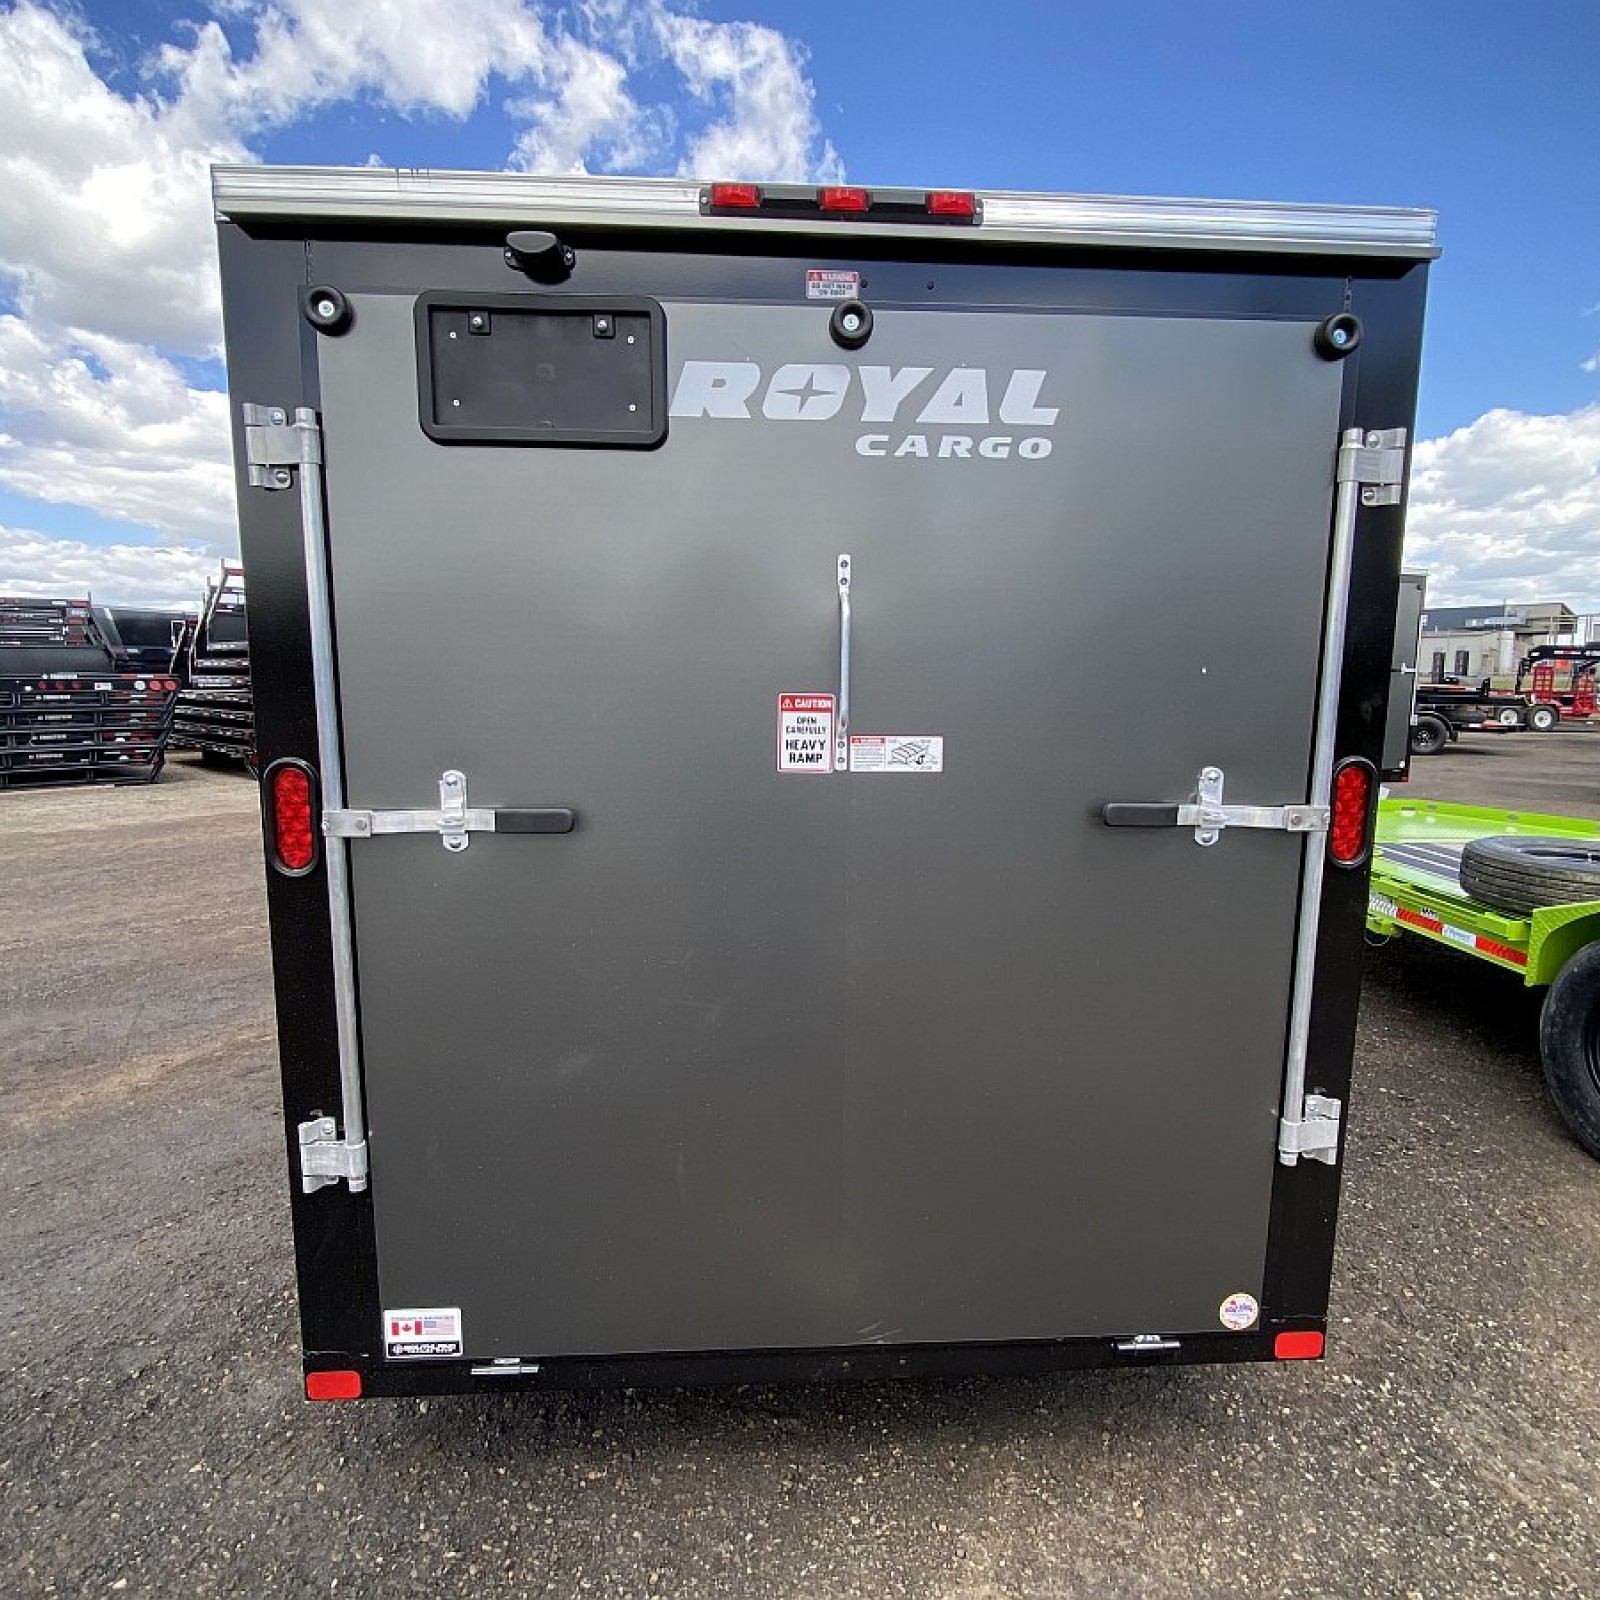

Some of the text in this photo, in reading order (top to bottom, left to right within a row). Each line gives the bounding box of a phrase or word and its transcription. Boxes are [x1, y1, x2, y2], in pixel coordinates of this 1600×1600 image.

[667, 360, 1059, 426] ROYAL
[855, 434, 1053, 460] CARGO
[795, 699, 832, 709] CAUTION
[796, 716, 817, 725] OPEN
[786, 739, 826, 751] HEAVY
[789, 752, 823, 764] RAMP
